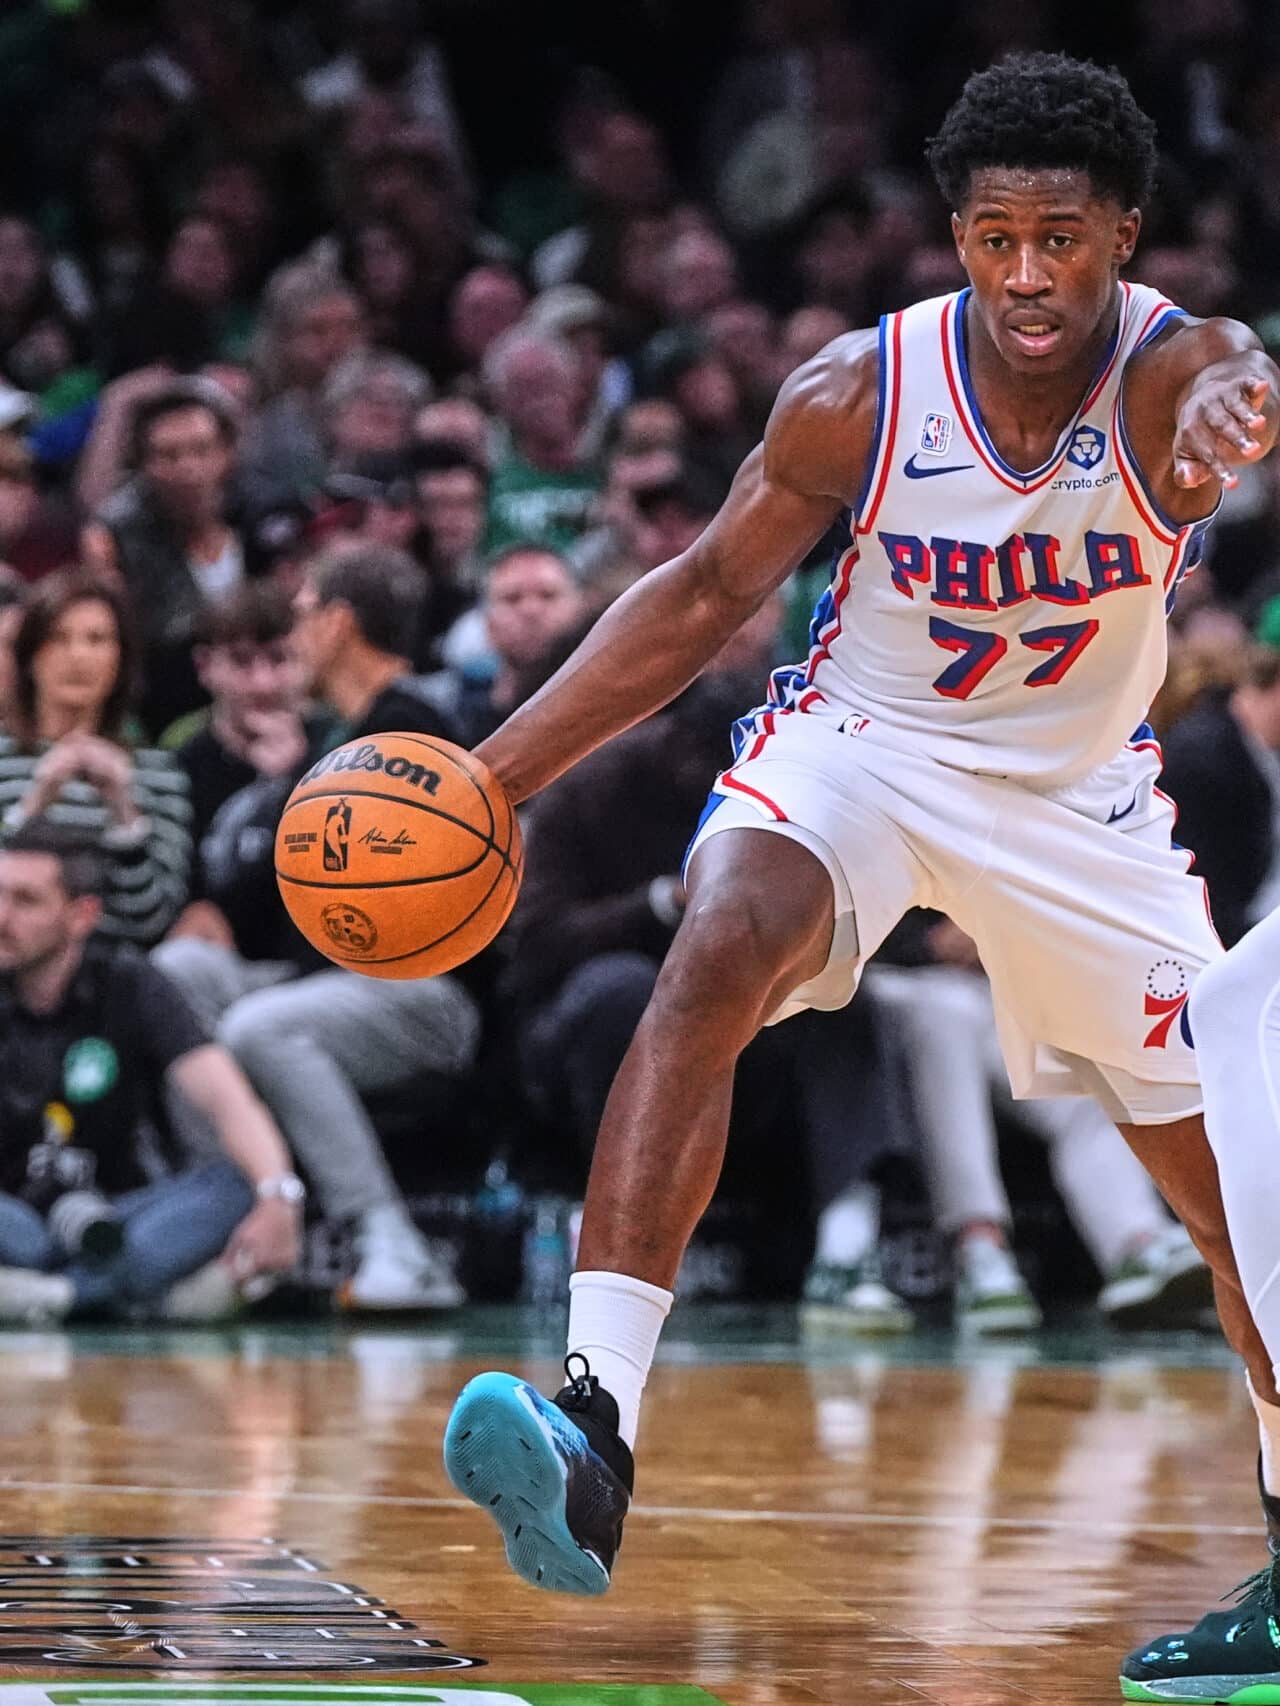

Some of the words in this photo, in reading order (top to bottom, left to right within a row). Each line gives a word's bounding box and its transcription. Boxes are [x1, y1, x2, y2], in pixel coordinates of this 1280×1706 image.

[1051, 472, 1120, 491] crypto.com
[878, 529, 1152, 612] PHILA
[929, 615, 1099, 701] 77
[1143, 989, 1195, 1051] 7
